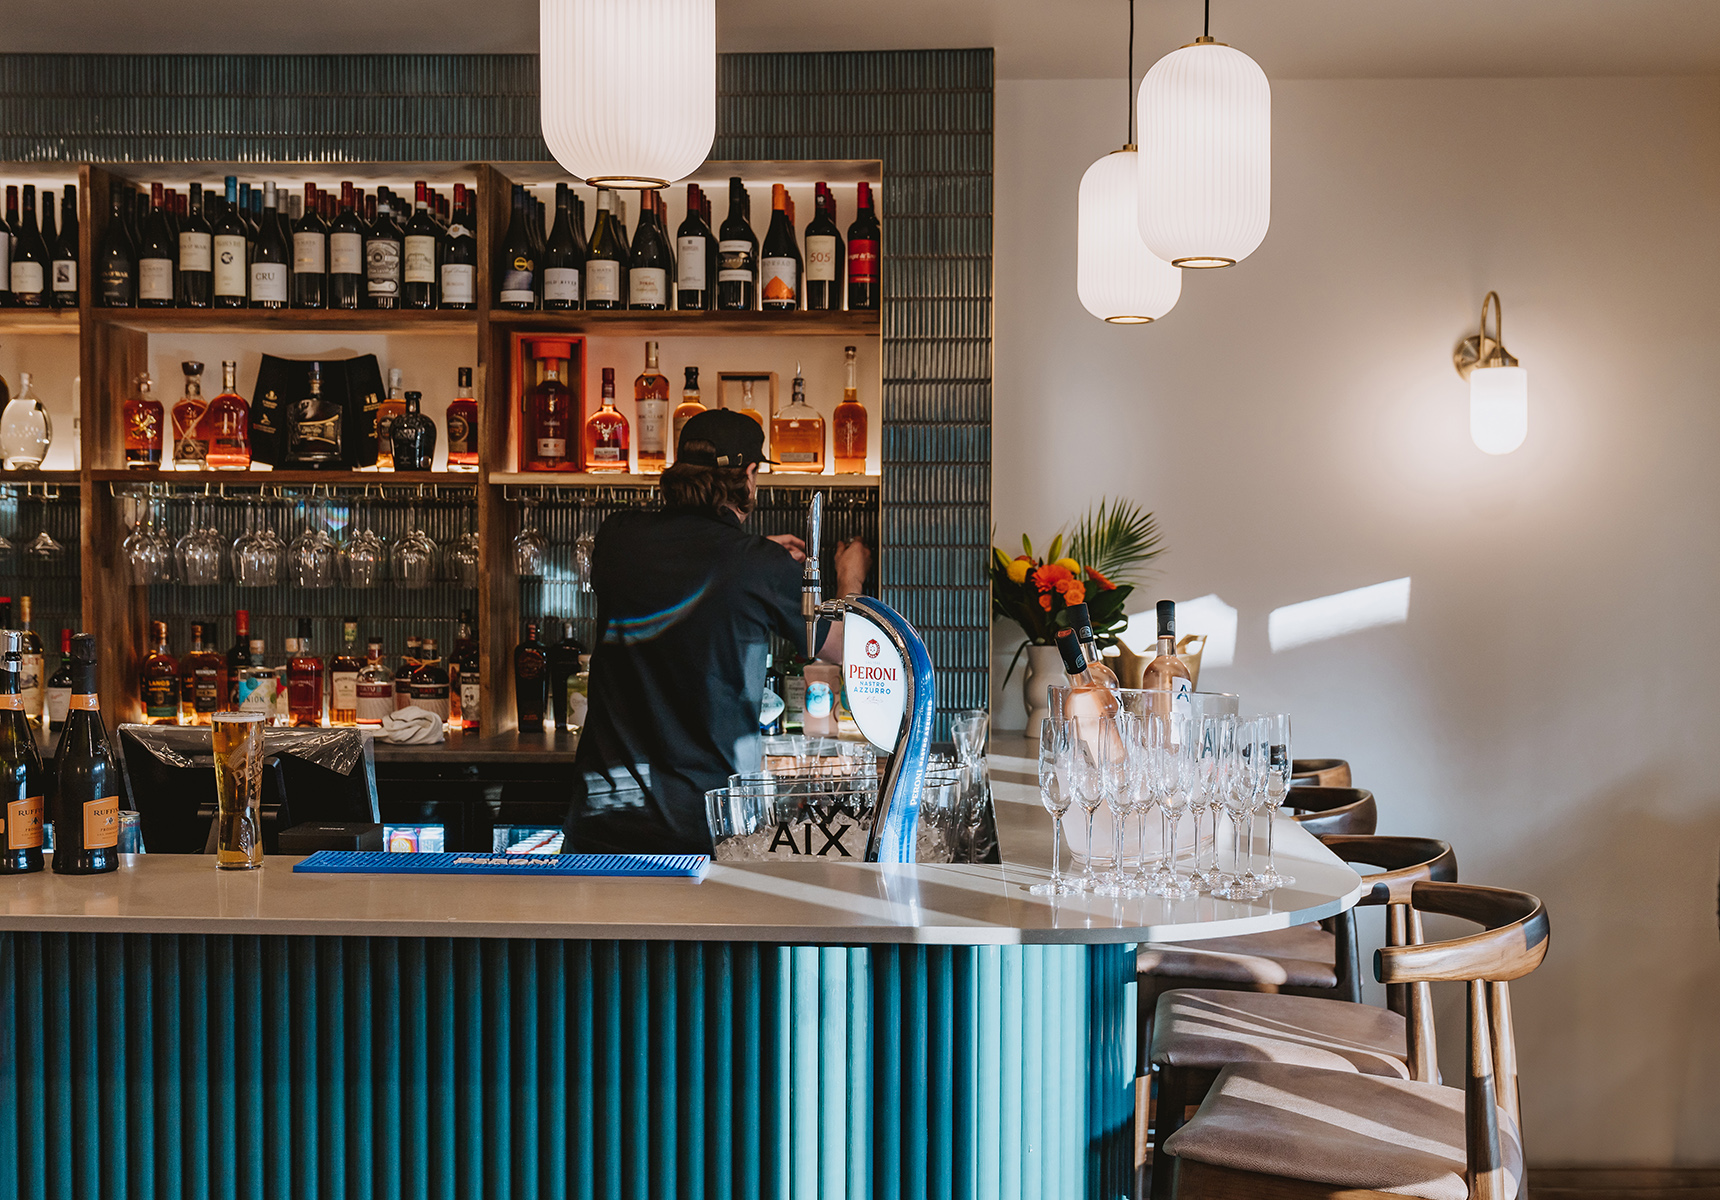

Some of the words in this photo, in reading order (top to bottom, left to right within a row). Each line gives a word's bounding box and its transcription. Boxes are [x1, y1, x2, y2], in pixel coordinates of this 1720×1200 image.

[810, 252, 831, 263] 505
[255, 272, 275, 281] CRU
[646, 424, 654, 432] 12
[849, 664, 897, 681] PERONI
[853, 686, 891, 695] AZZURRO
[910, 769, 923, 806] PERONI
[919, 737, 928, 767] NASTRO
[924, 700, 933, 736] AZZURRO
[768, 821, 853, 857] AIX
